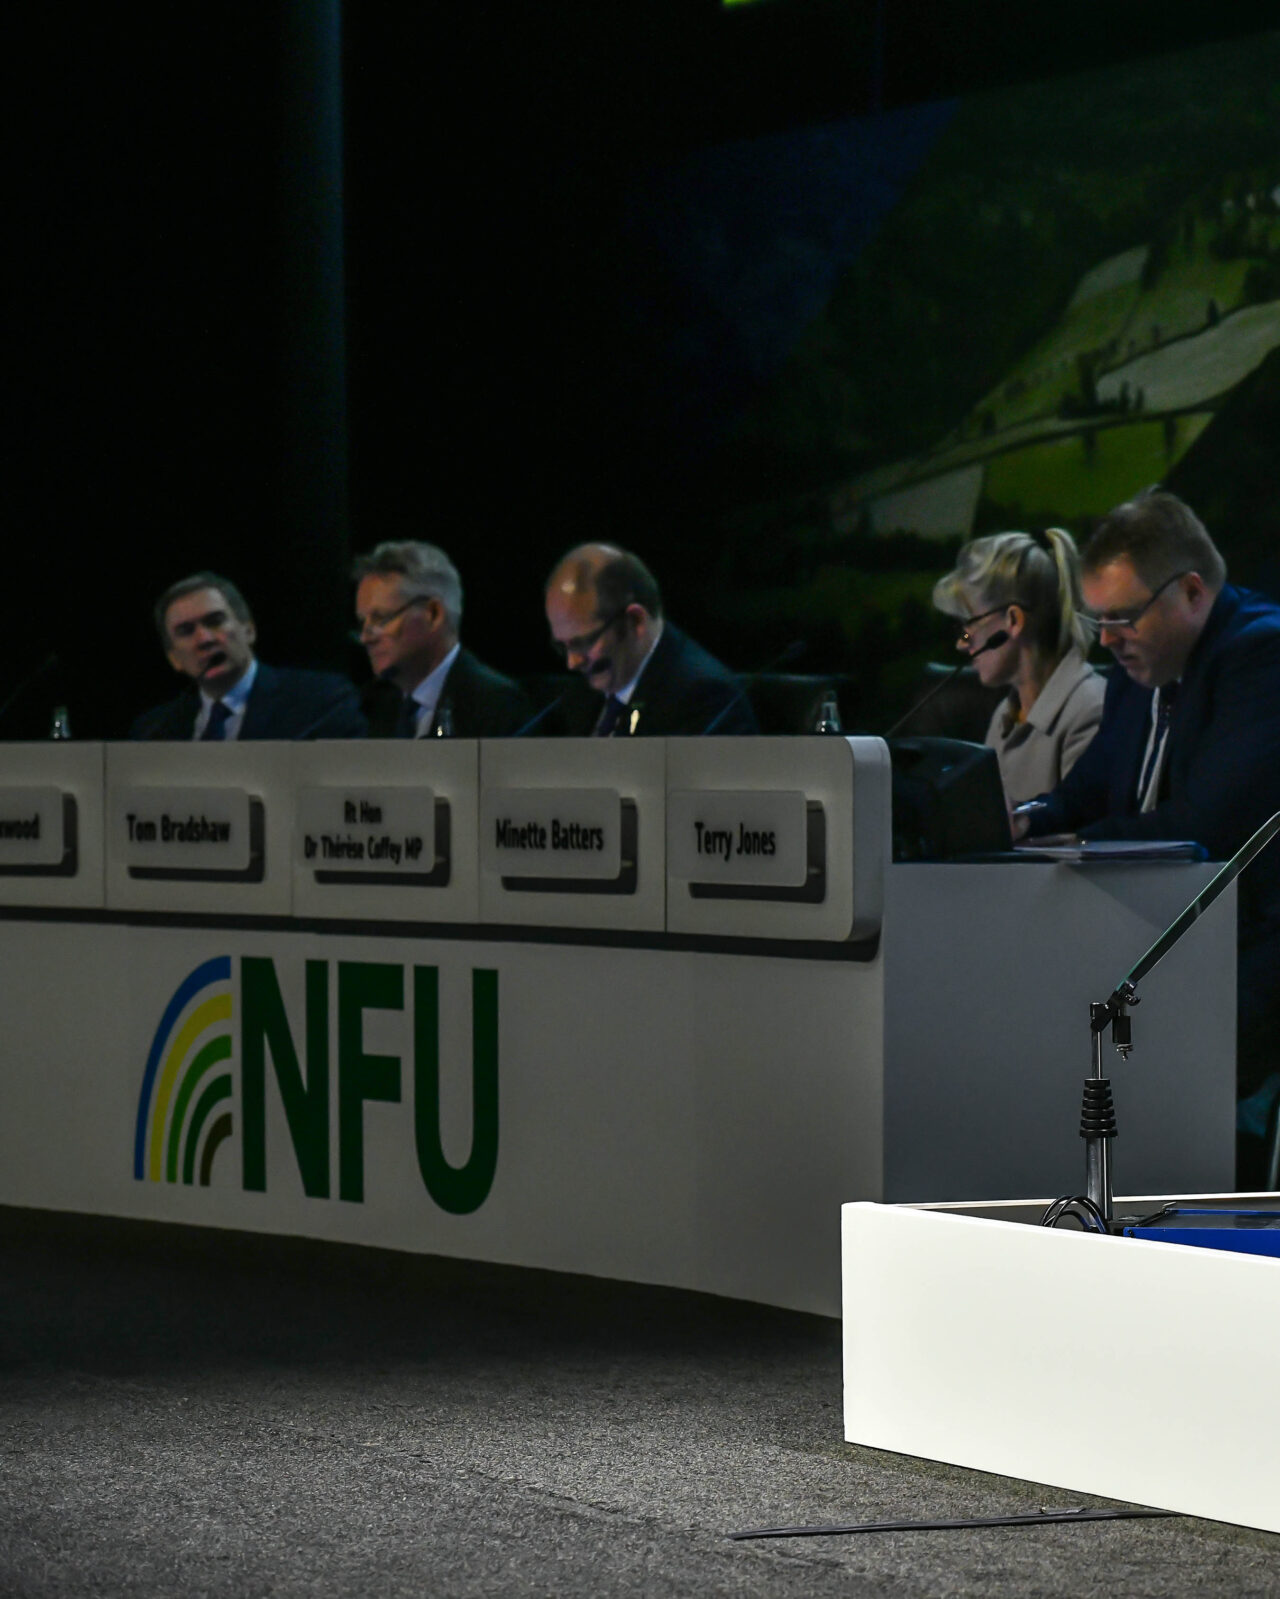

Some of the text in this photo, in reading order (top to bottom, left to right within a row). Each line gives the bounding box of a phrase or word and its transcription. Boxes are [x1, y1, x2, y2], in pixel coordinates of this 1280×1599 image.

[126, 813, 231, 843] Tom Bradshaw
[496, 818, 604, 851] Minette Batters
[694, 821, 776, 862] Terry Jones
[304, 835, 317, 859] Dr
[367, 835, 402, 865] Coffey
[405, 836, 422, 860] MP
[240, 956, 499, 1215] NFU
